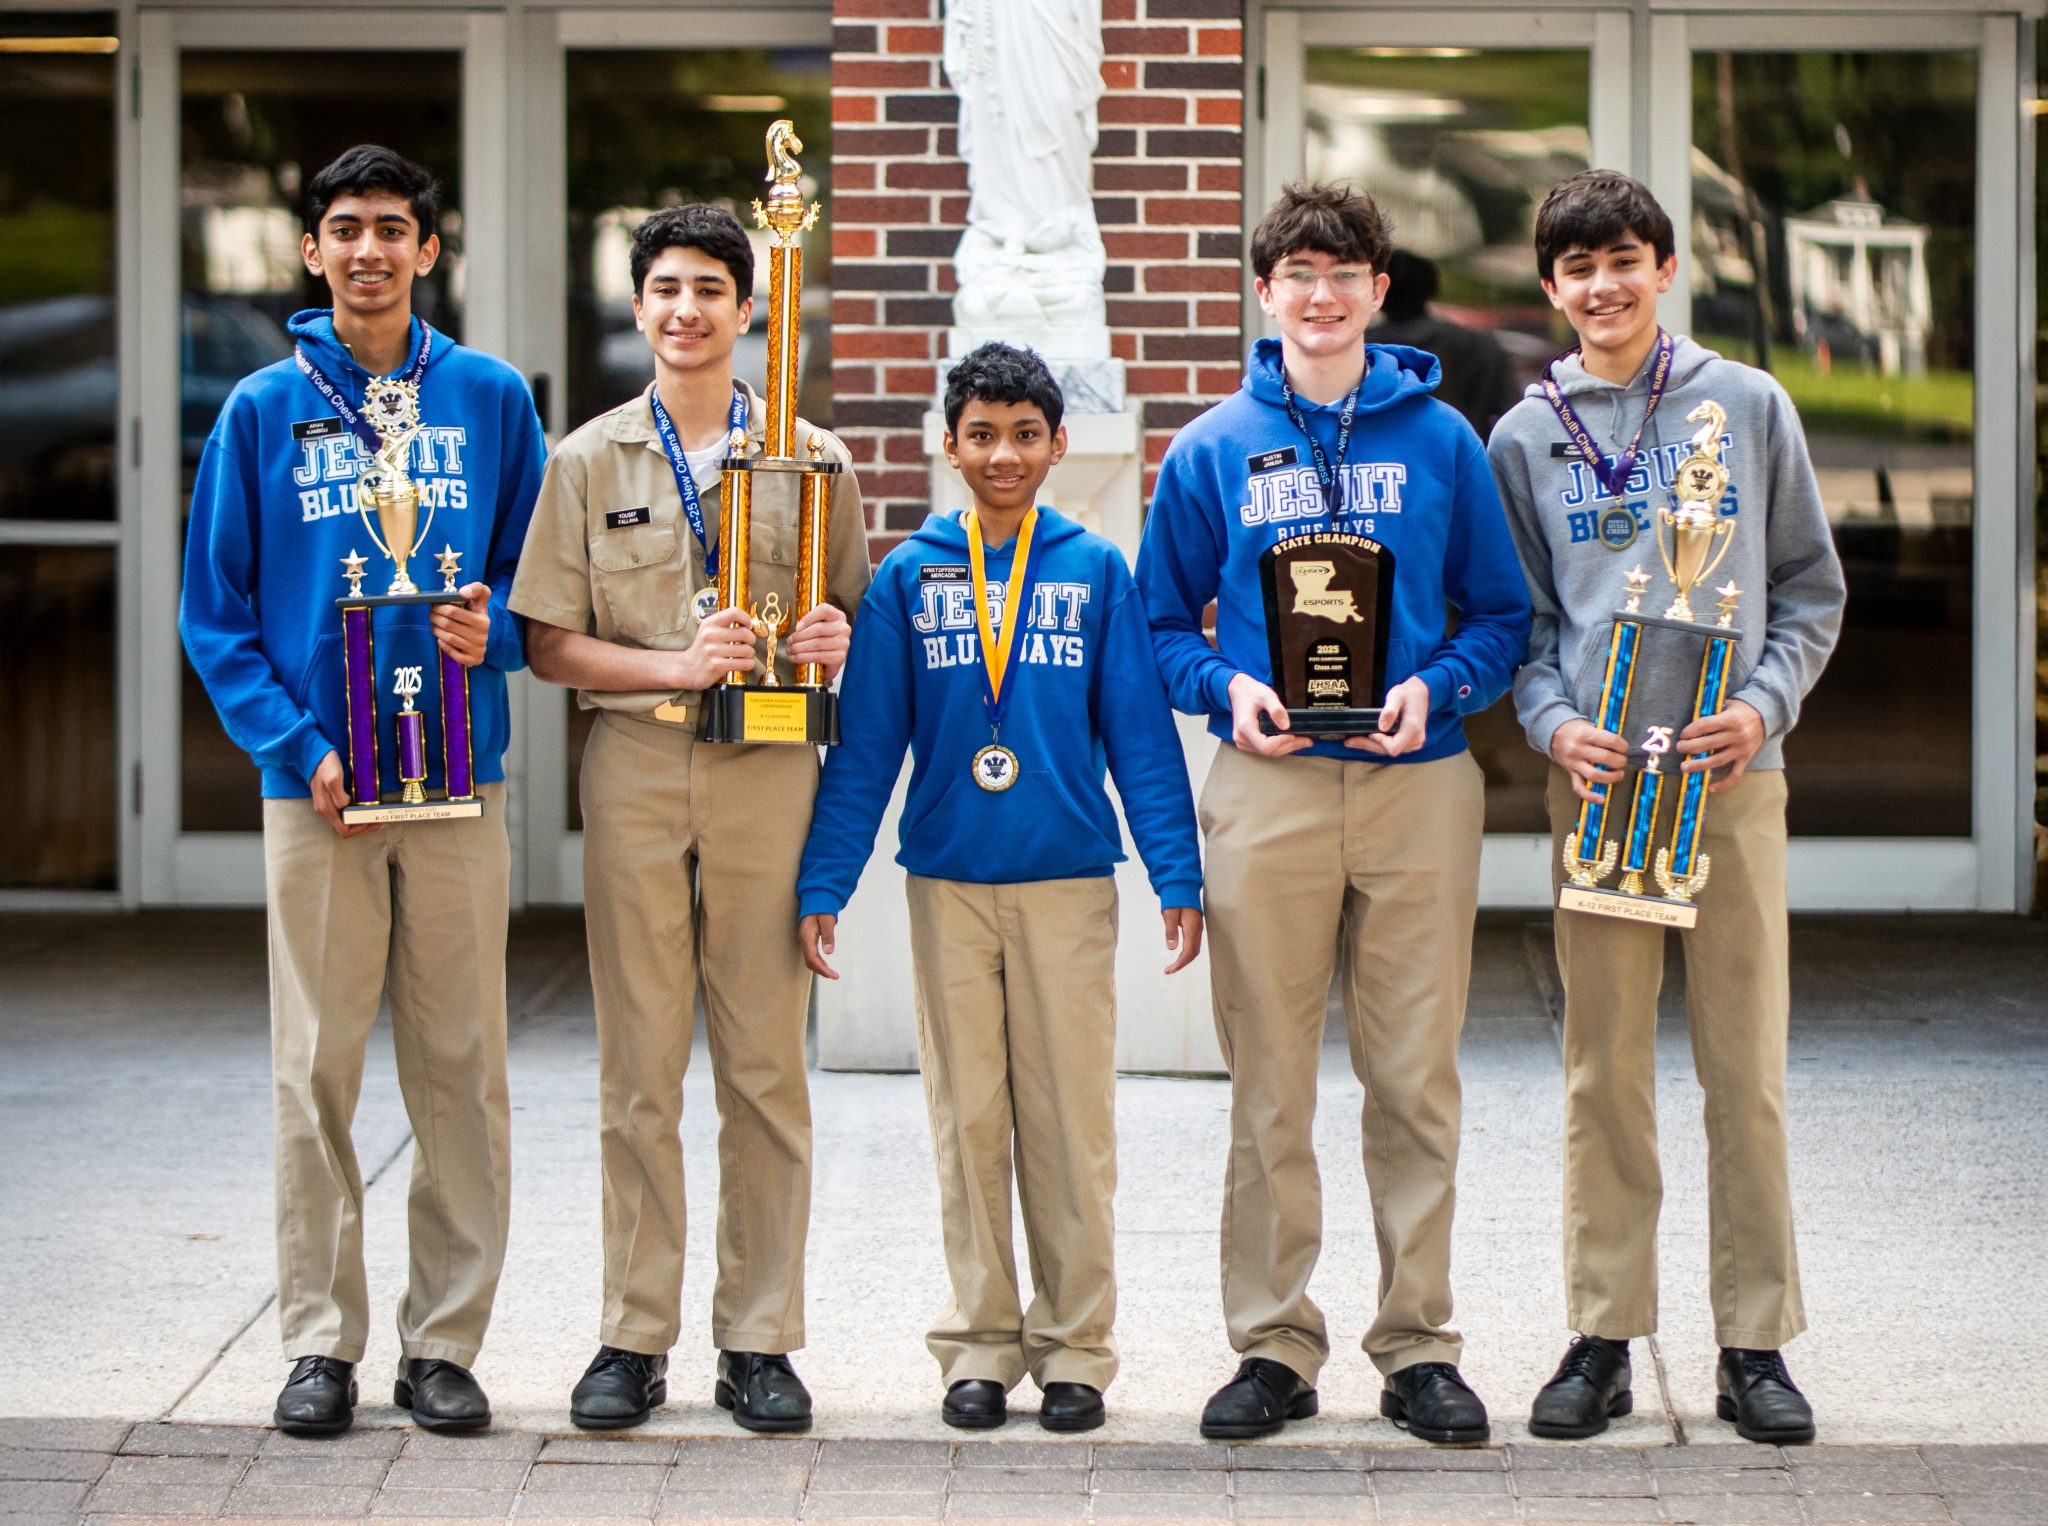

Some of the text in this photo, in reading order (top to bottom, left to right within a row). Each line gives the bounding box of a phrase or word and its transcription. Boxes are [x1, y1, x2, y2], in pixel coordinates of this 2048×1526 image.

[1652, 351, 1671, 391] Orleans
[311, 369, 334, 397] Youth
[331, 394, 357, 424] Chess
[1644, 394, 1660, 420] You
[655, 404, 672, 434] Youth
[733, 402, 744, 425] New
[1338, 428, 1349, 453] New
[1559, 404, 1580, 434] Youth
[1576, 433, 1599, 465] Chess
[294, 426, 467, 487] JESIT
[667, 433, 687, 474] Orleans
[1262, 452, 1282, 463] AUSTIN
[1314, 449, 1331, 485] Chess
[1561, 433, 1734, 509] JSU
[299, 477, 468, 522] BLU AYS
[681, 475, 696, 501] New
[618, 510, 637, 519] YOUSEF
[687, 502, 704, 535] 24-25
[1566, 501, 1650, 543] BLE
[1271, 533, 1382, 556] STATE CHAMPION
[913, 581, 1091, 633] JESIT
[1303, 598, 1345, 606] ESPORTS
[923, 631, 988, 670] BLU
[1316, 644, 1340, 654] 2025
[393, 665, 422, 694] 2025
[1309, 679, 1349, 691] LHSAA
[747, 724, 765, 732] FIRST
[786, 725, 804, 733] TEAM
[1641, 726, 1675, 753] 25
[390, 812, 408, 820] FIRST
[409, 811, 430, 819] PLACE
[432, 810, 451, 818] TEAM
[1577, 900, 1597, 910] K-12
[1597, 902, 1623, 913] FIRST
[1623, 906, 1652, 918] PLACE
[1654, 911, 1678, 922] TEAM
